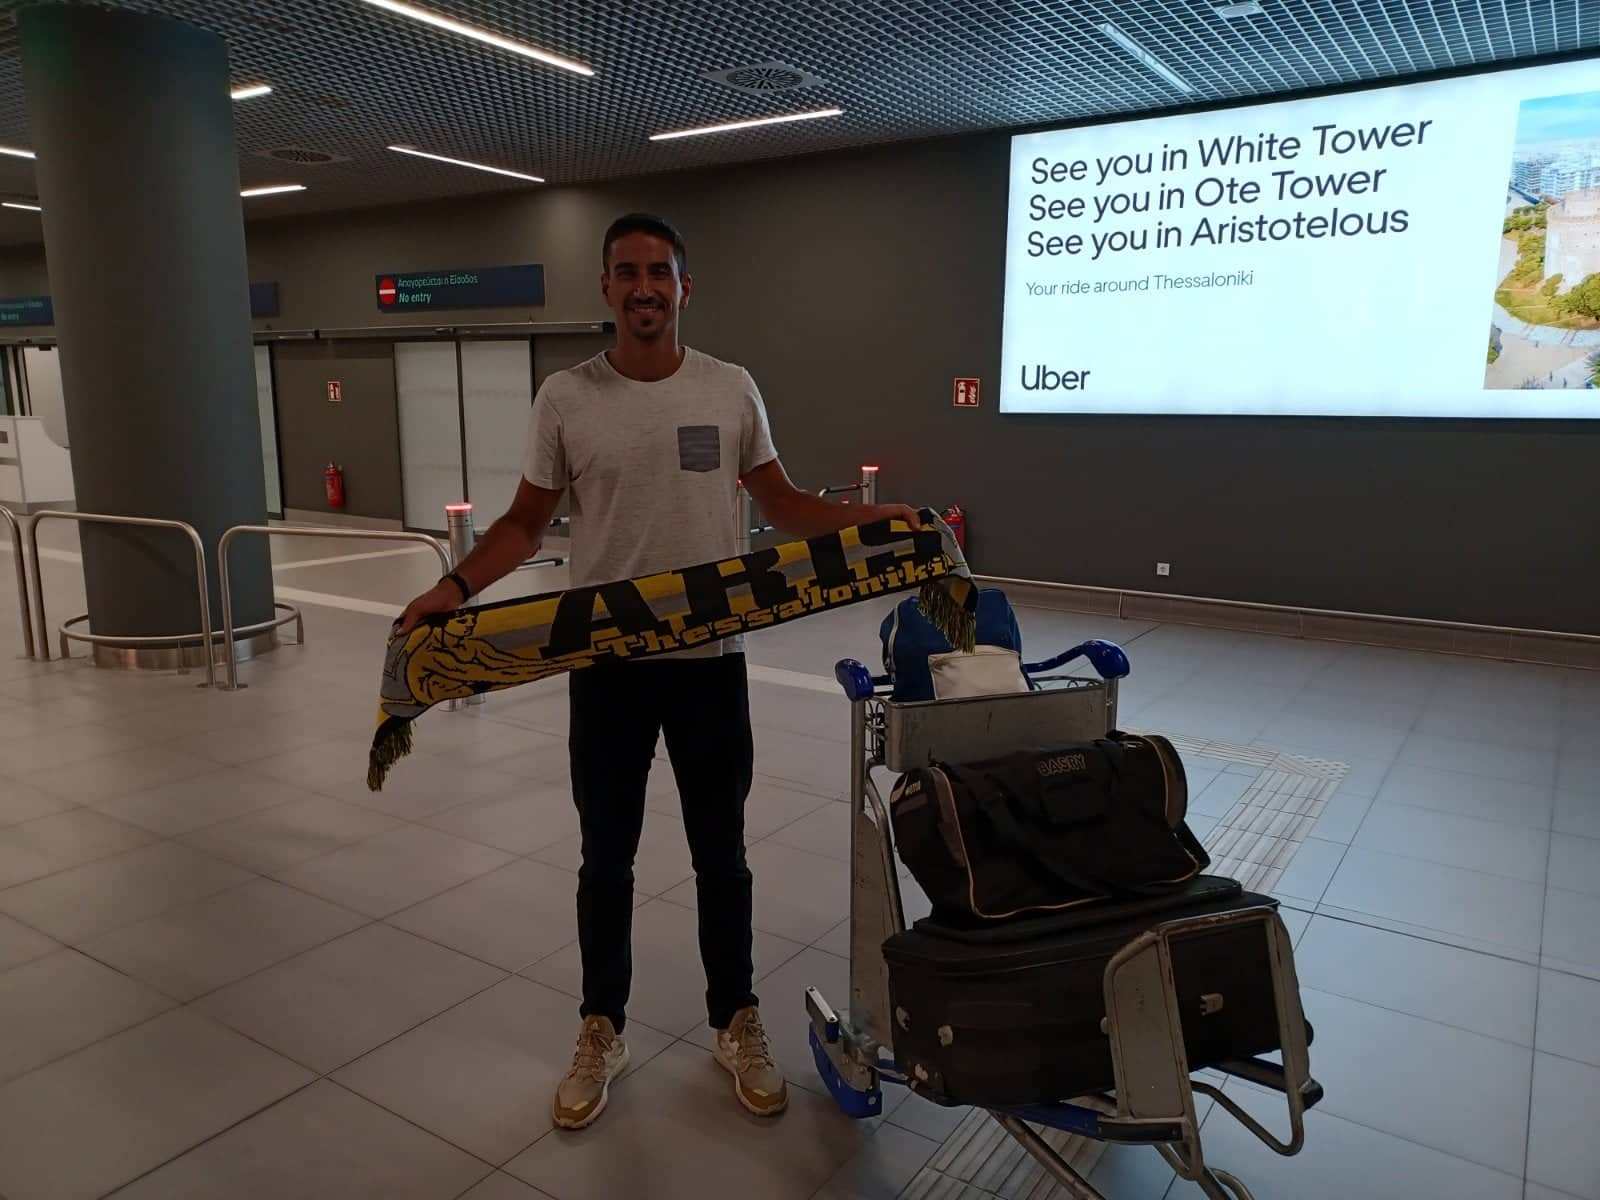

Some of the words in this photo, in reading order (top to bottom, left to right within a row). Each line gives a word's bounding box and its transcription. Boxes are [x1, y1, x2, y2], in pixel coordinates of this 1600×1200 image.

[1032, 157, 1088, 185] See
[1096, 152, 1153, 186] you
[1161, 144, 1188, 171] in
[1198, 132, 1301, 167] White
[1313, 119, 1433, 155] Tower
[1029, 194, 1086, 221] See
[1094, 189, 1150, 223] you
[1159, 183, 1185, 210] in
[1195, 177, 1260, 207] Ote
[1272, 168, 1387, 200] Tower
[1027, 230, 1083, 257] See
[1091, 227, 1148, 260] you
[1156, 221, 1182, 248] in
[1190, 208, 1409, 246] Aristotelous
[398, 293, 410, 304] No
[412, 292, 432, 304] entry
[1026, 281, 1058, 296] Your
[1061, 279, 1090, 295] ride
[1094, 276, 1149, 293] around
[1153, 270, 1254, 291] Thessaloniki
[1021, 364, 1091, 391] Uber
[594, 556, 946, 657] Thessaloniki
